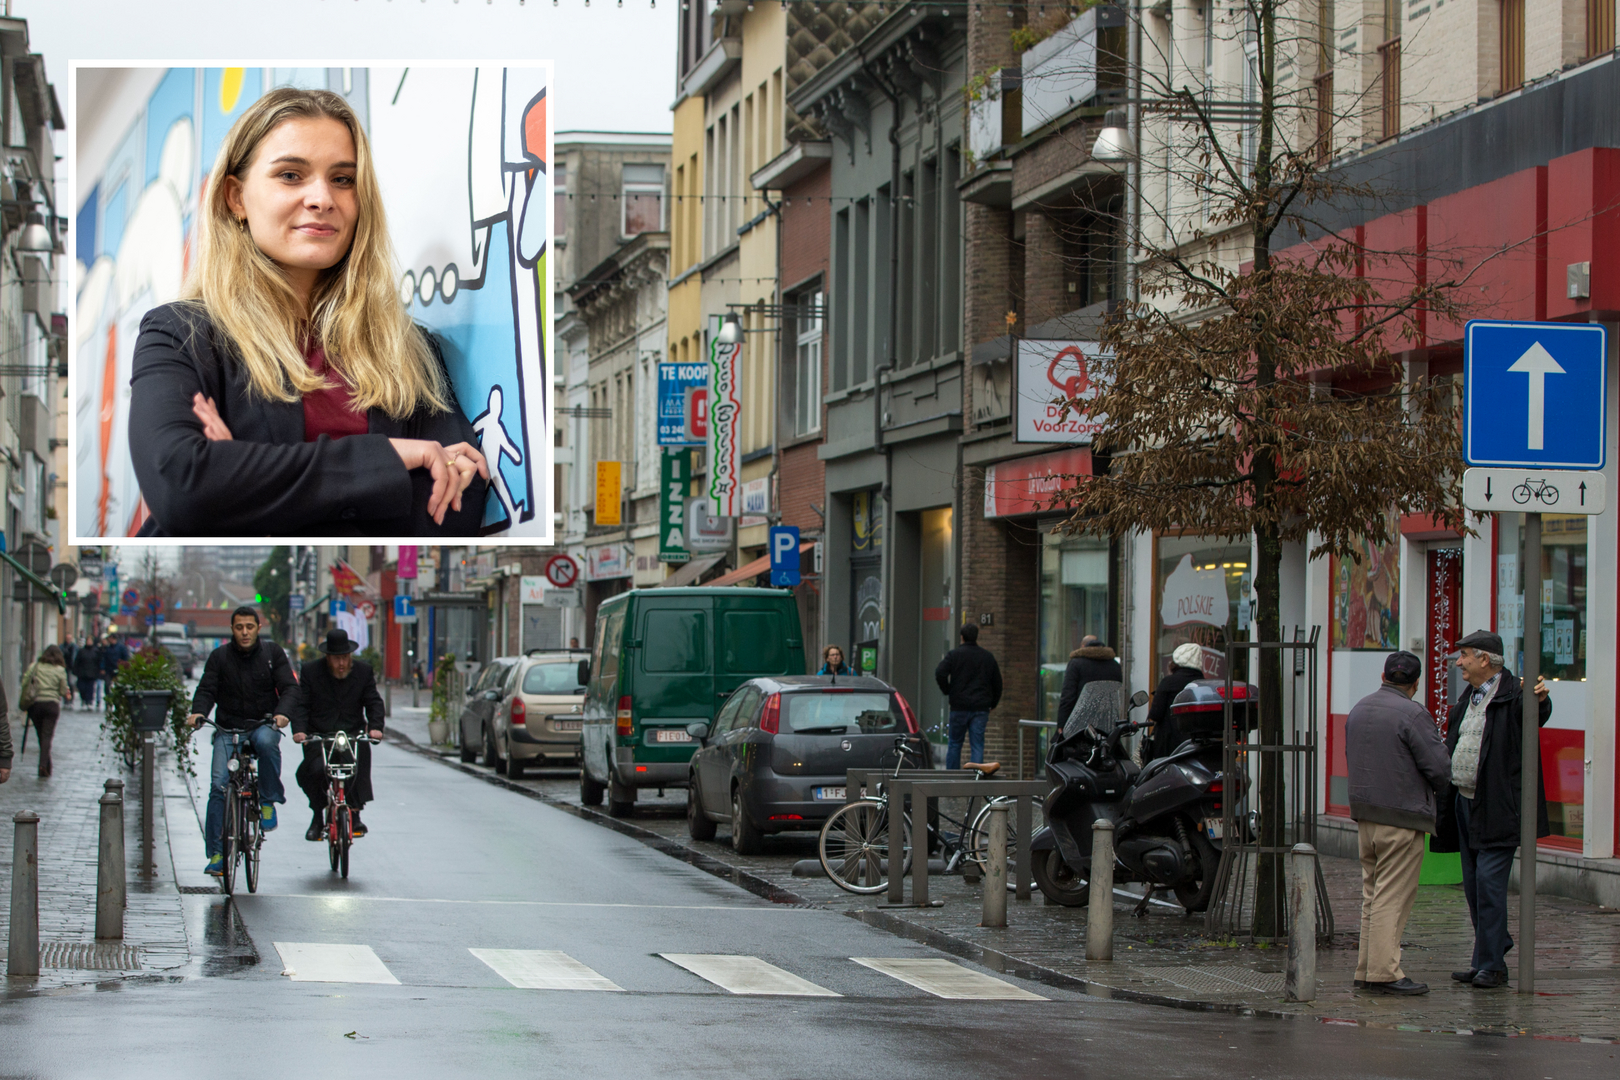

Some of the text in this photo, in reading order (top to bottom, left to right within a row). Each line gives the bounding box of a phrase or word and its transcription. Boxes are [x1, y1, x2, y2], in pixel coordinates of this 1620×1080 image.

[660, 366, 709, 380] TE KOOP
[717, 342, 735, 475] Pico Bello
[1046, 405, 1066, 419] De
[660, 425, 671, 434] 03
[1033, 419, 1104, 434] VoorZorg
[1177, 594, 1215, 619] POLSKIE
[981, 613, 991, 625] 81
